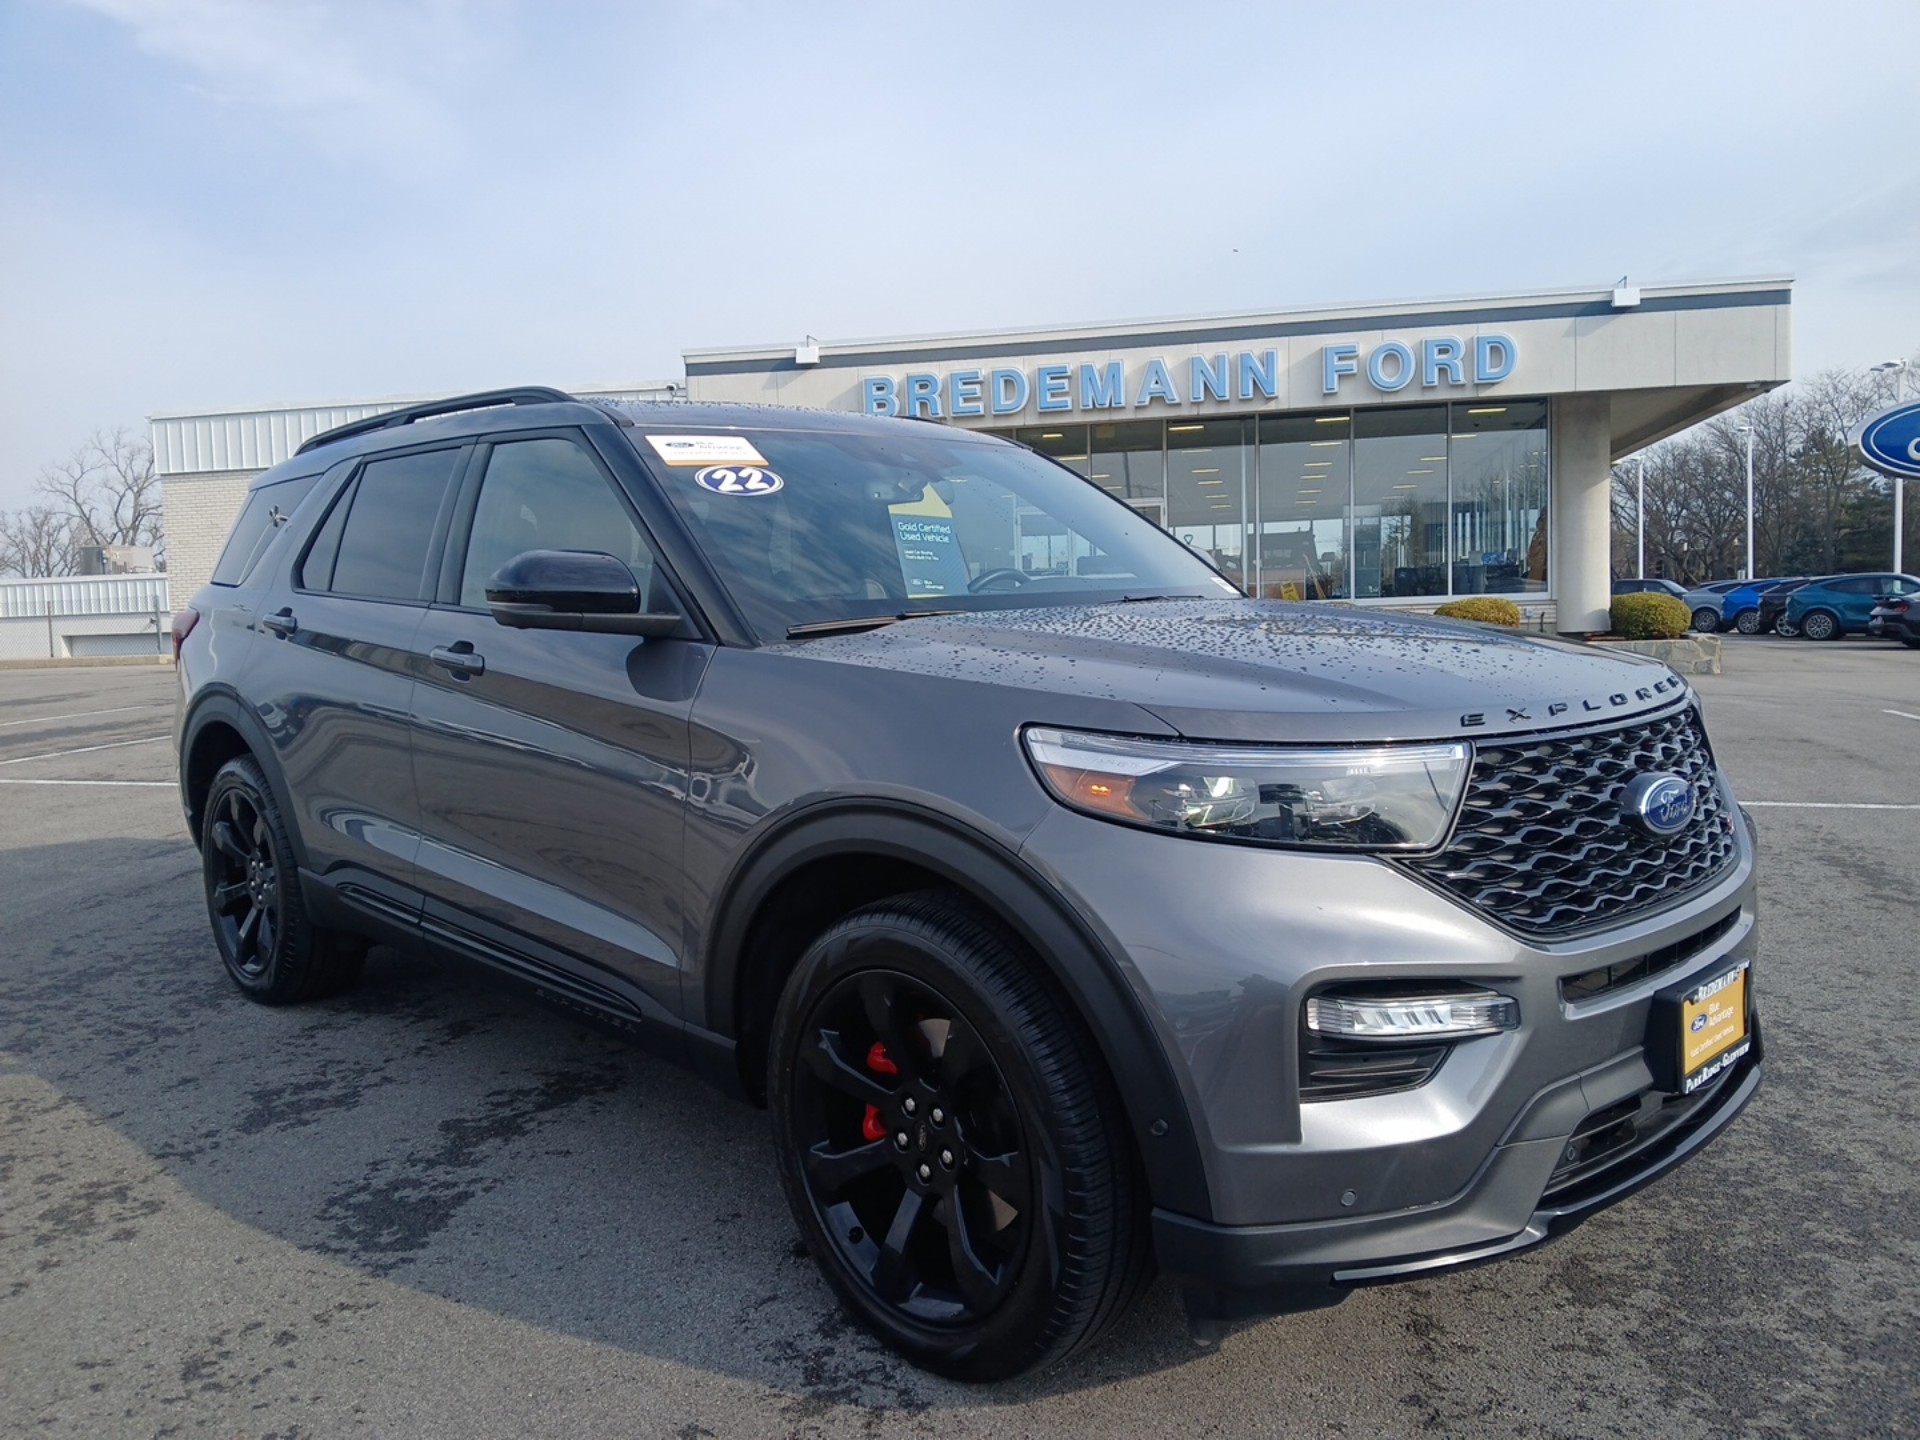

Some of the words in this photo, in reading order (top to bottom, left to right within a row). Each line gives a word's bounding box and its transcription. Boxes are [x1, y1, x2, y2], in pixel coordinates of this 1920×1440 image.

[863, 348, 1278, 419] BREDEMANN
[1322, 331, 1518, 394] FORD
[711, 467, 770, 492] 22
[898, 522, 917, 532] Gold
[918, 523, 951, 534] Certified
[900, 532, 921, 541] Used
[921, 533, 950, 544] Vehicle
[1460, 675, 1680, 727] EXPLORER
[1660, 789, 1690, 822] Ford
